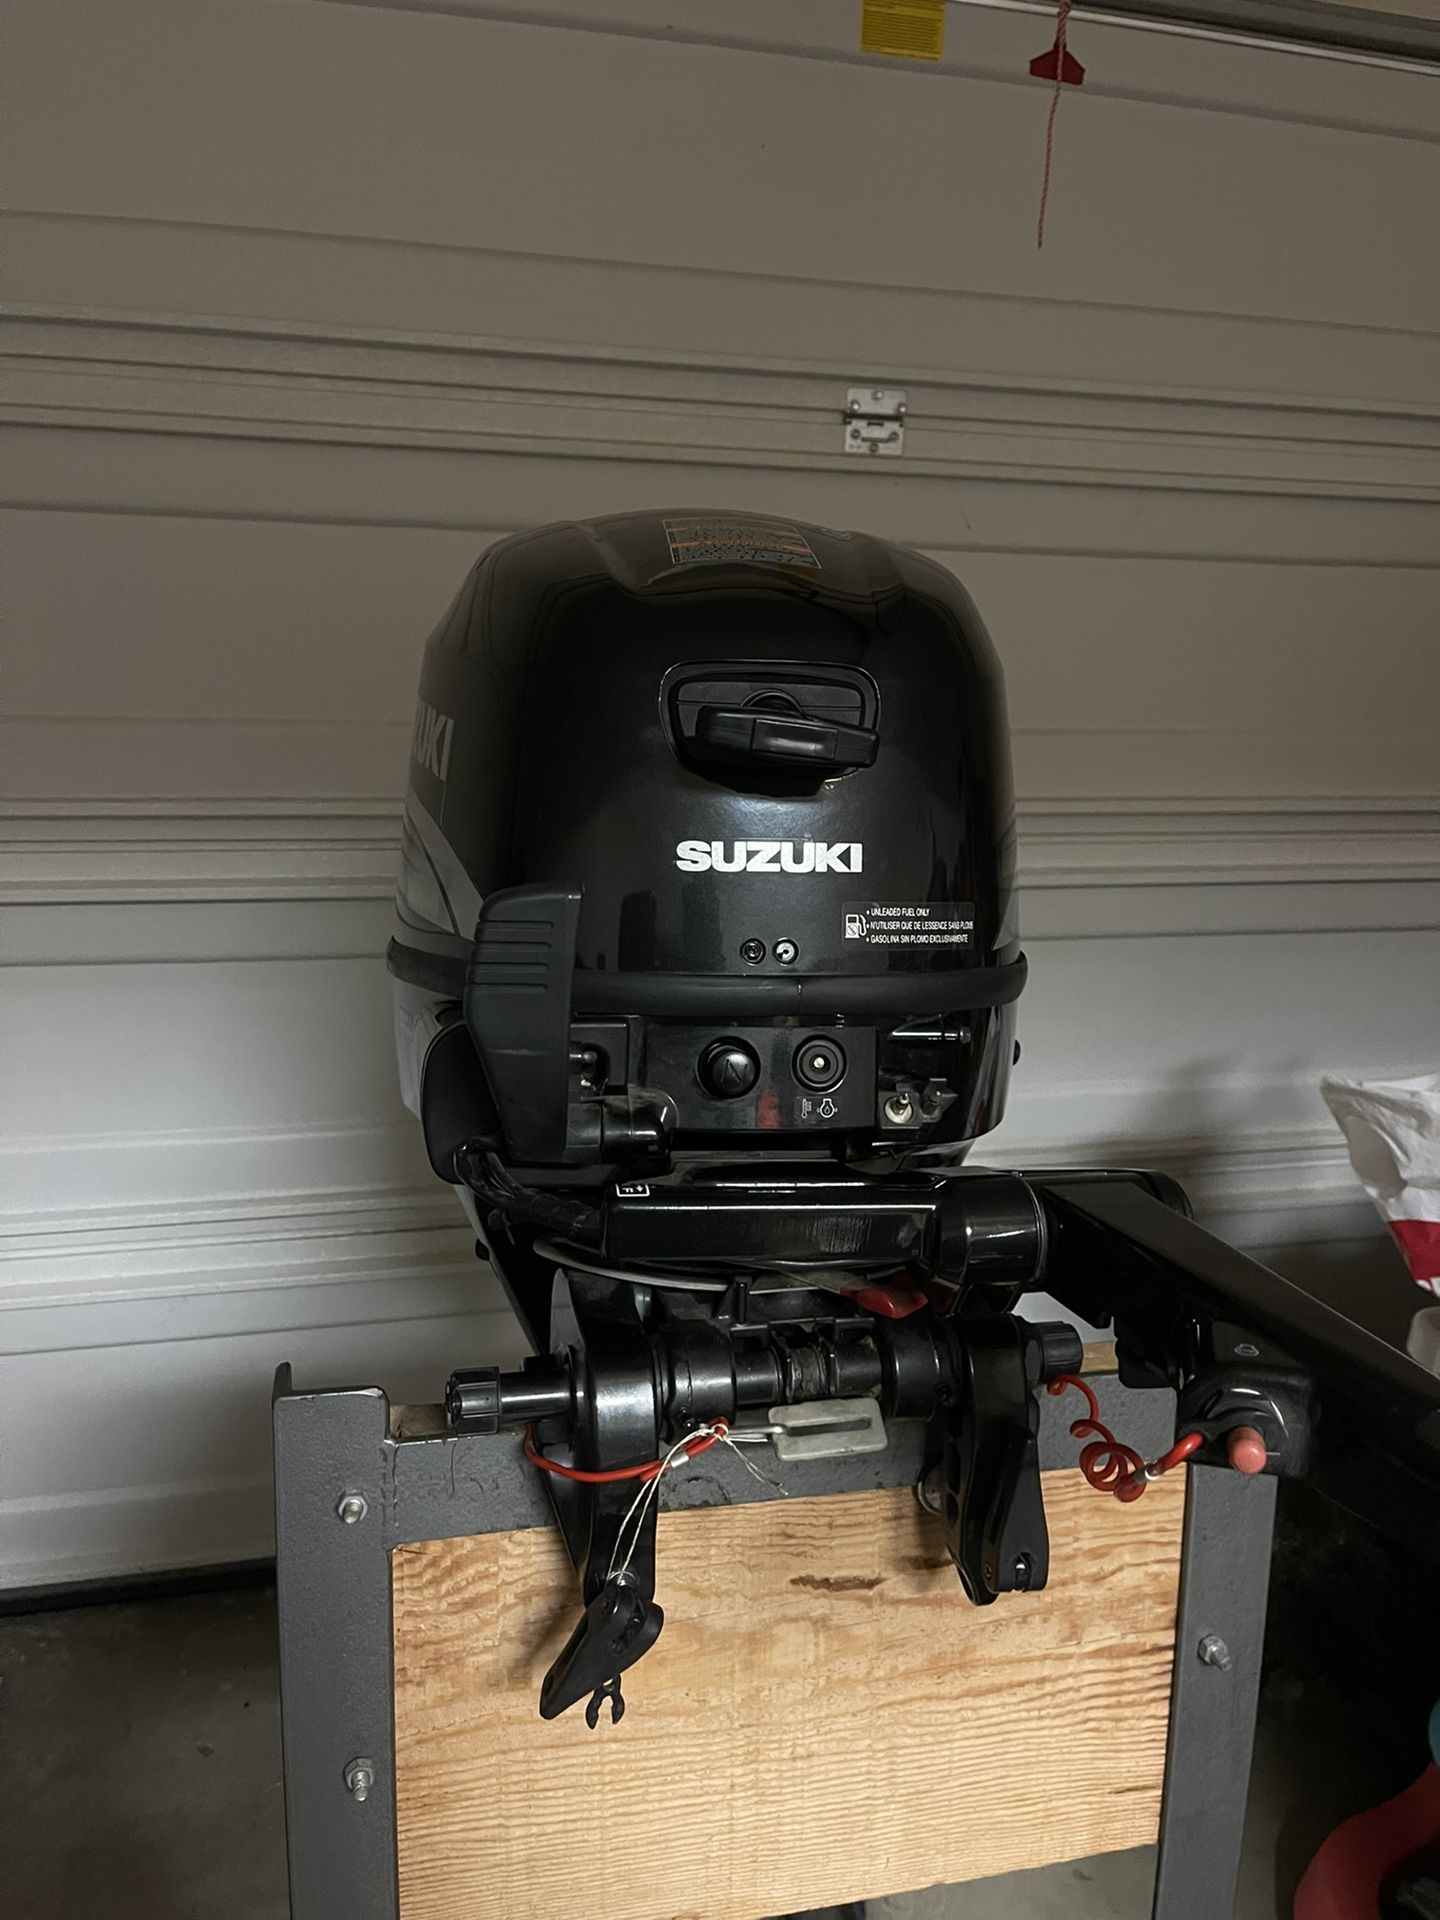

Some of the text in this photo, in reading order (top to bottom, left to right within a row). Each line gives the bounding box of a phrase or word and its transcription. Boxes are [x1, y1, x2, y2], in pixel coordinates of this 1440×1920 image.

[417, 702, 454, 781] UKI
[676, 840, 863, 873] SUZUKI
[870, 907, 930, 917] UNLEADED FUEL ONLY
[901, 921, 913, 930] QUE
[913, 921, 922, 930] DE
[870, 934, 900, 944] GASOLINA
[900, 934, 910, 944] SIN
[910, 934, 929, 944] PLOMO
